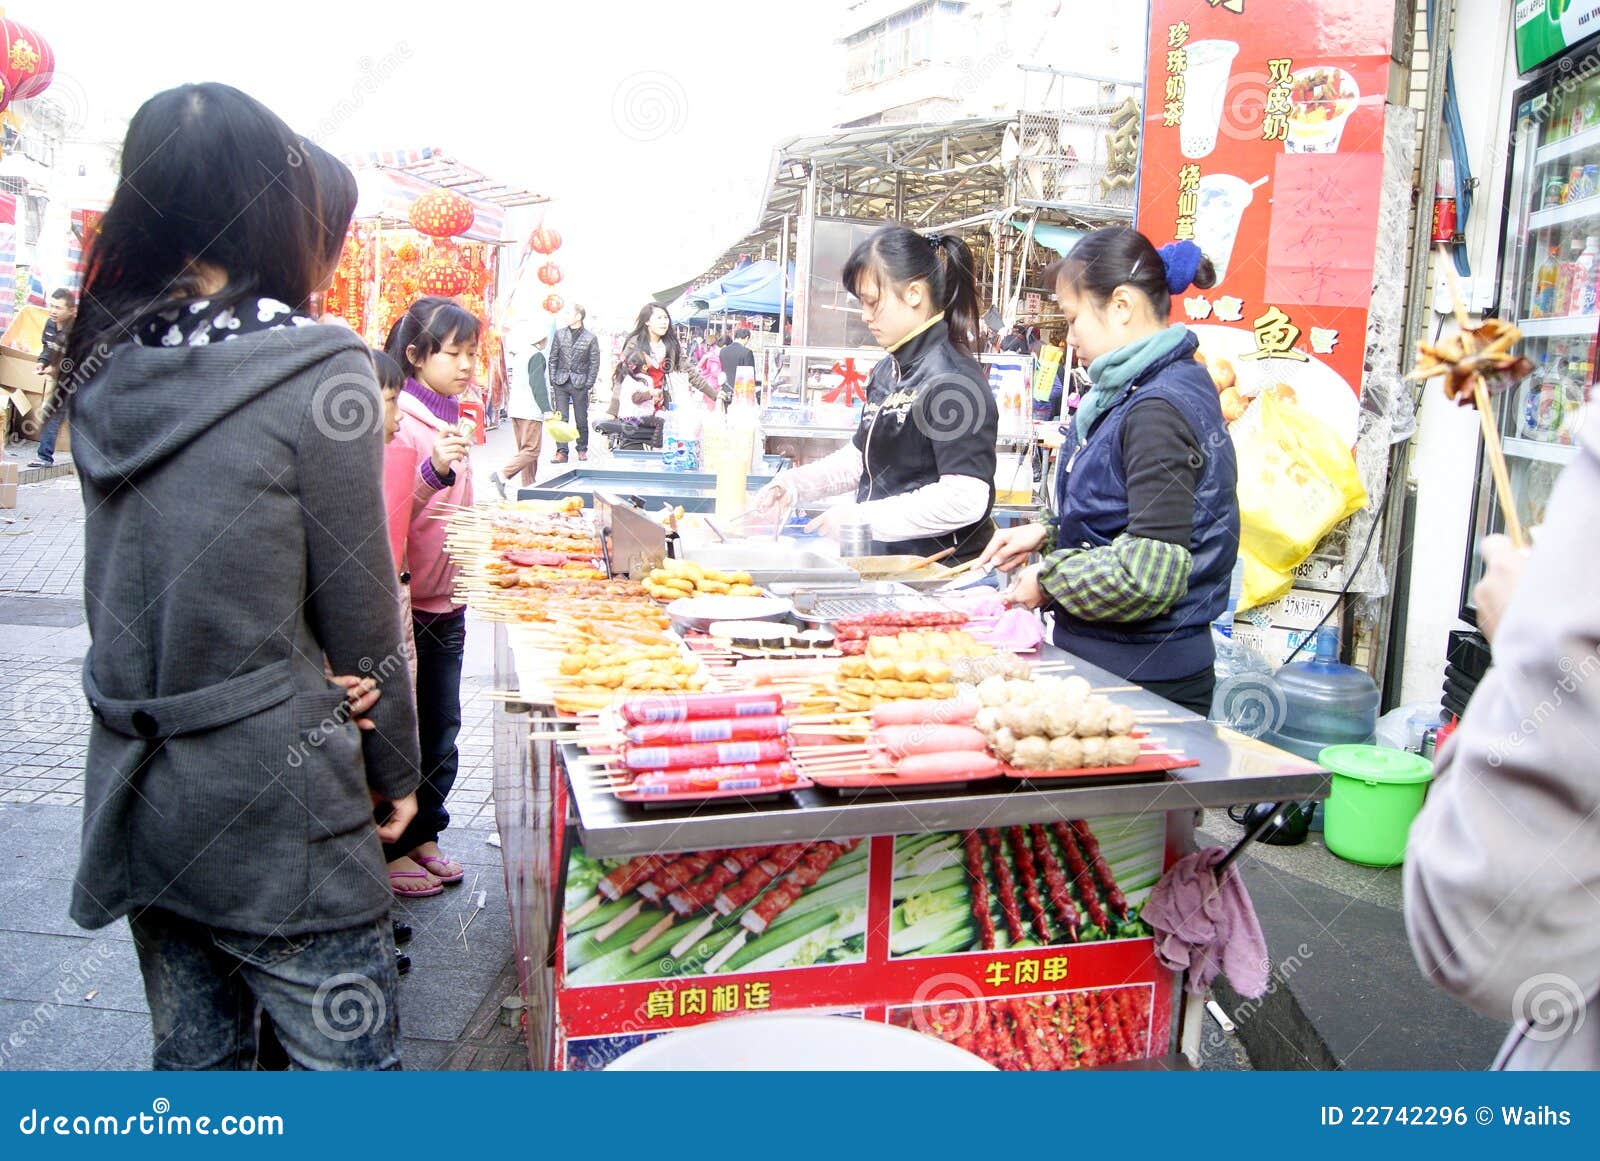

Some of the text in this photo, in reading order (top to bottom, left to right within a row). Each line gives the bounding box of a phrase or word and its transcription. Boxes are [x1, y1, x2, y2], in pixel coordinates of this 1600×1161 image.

[1162, 21, 1190, 127] 珍珠奶茶
[1262, 58, 1293, 140] 双皮奶
[1174, 163, 1200, 240] 烧仙草
[647, 982, 771, 1019] 骨肉相连
[985, 957, 1068, 987] 牛肉串
